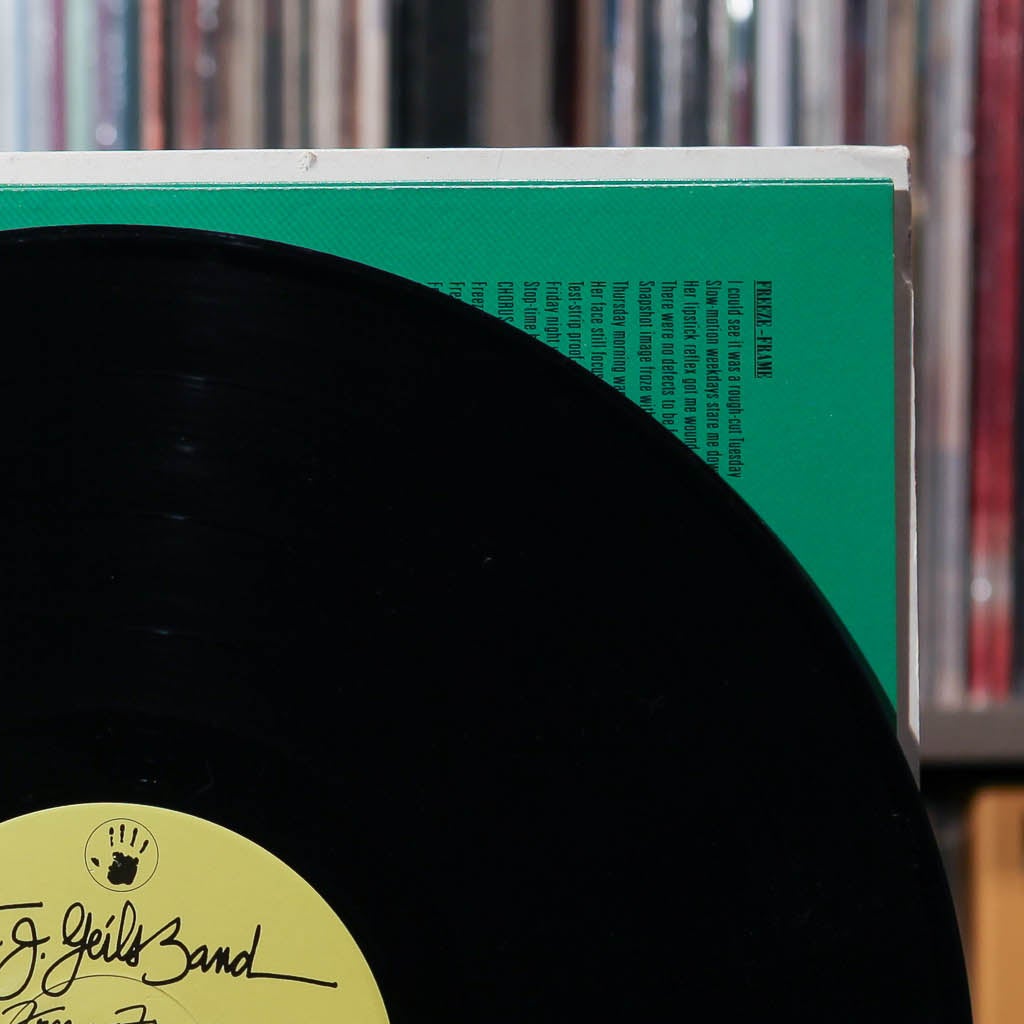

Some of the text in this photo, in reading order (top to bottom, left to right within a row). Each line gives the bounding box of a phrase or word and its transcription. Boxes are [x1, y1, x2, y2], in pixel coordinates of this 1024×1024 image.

[727, 288, 744, 315] could
[727, 319, 739, 337] see
[727, 352, 740, 372] was
[726, 385, 743, 434] rough-cut
[727, 438, 744, 478] Tuesday
[143, 917, 337, 987] Band
